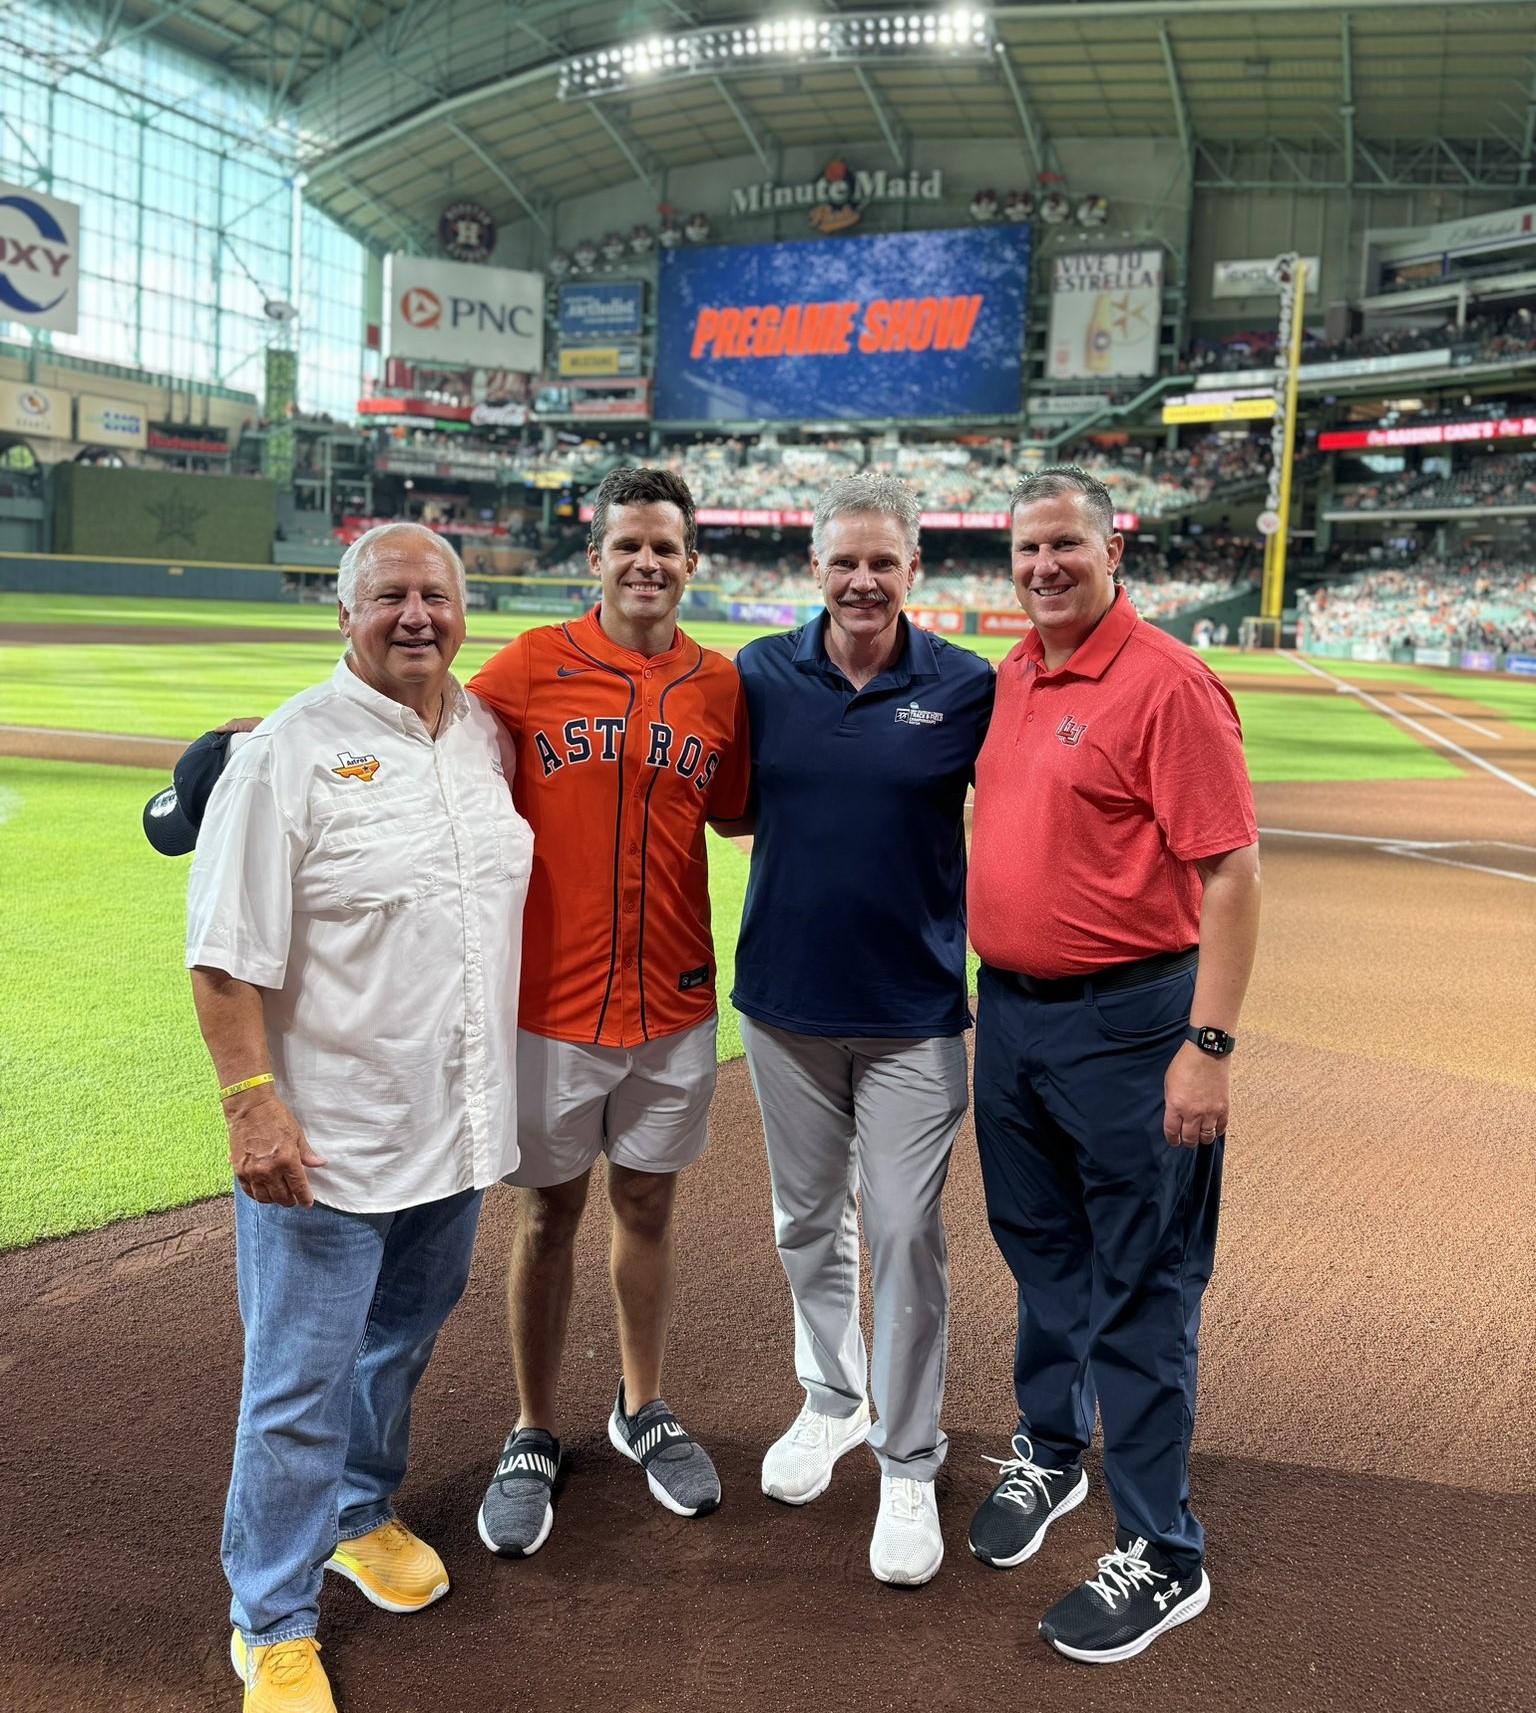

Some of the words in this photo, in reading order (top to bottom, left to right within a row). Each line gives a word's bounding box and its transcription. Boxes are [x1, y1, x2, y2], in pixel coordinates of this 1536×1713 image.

[730, 177, 848, 215] Minute
[853, 169, 942, 199] Maid
[0, 235, 70, 277] XY
[1115, 251, 1143, 270] TU
[449, 296, 534, 338] PNC
[690, 302, 859, 358] PREGAME
[858, 294, 984, 354] SHOW
[534, 717, 720, 791] ASTROS
